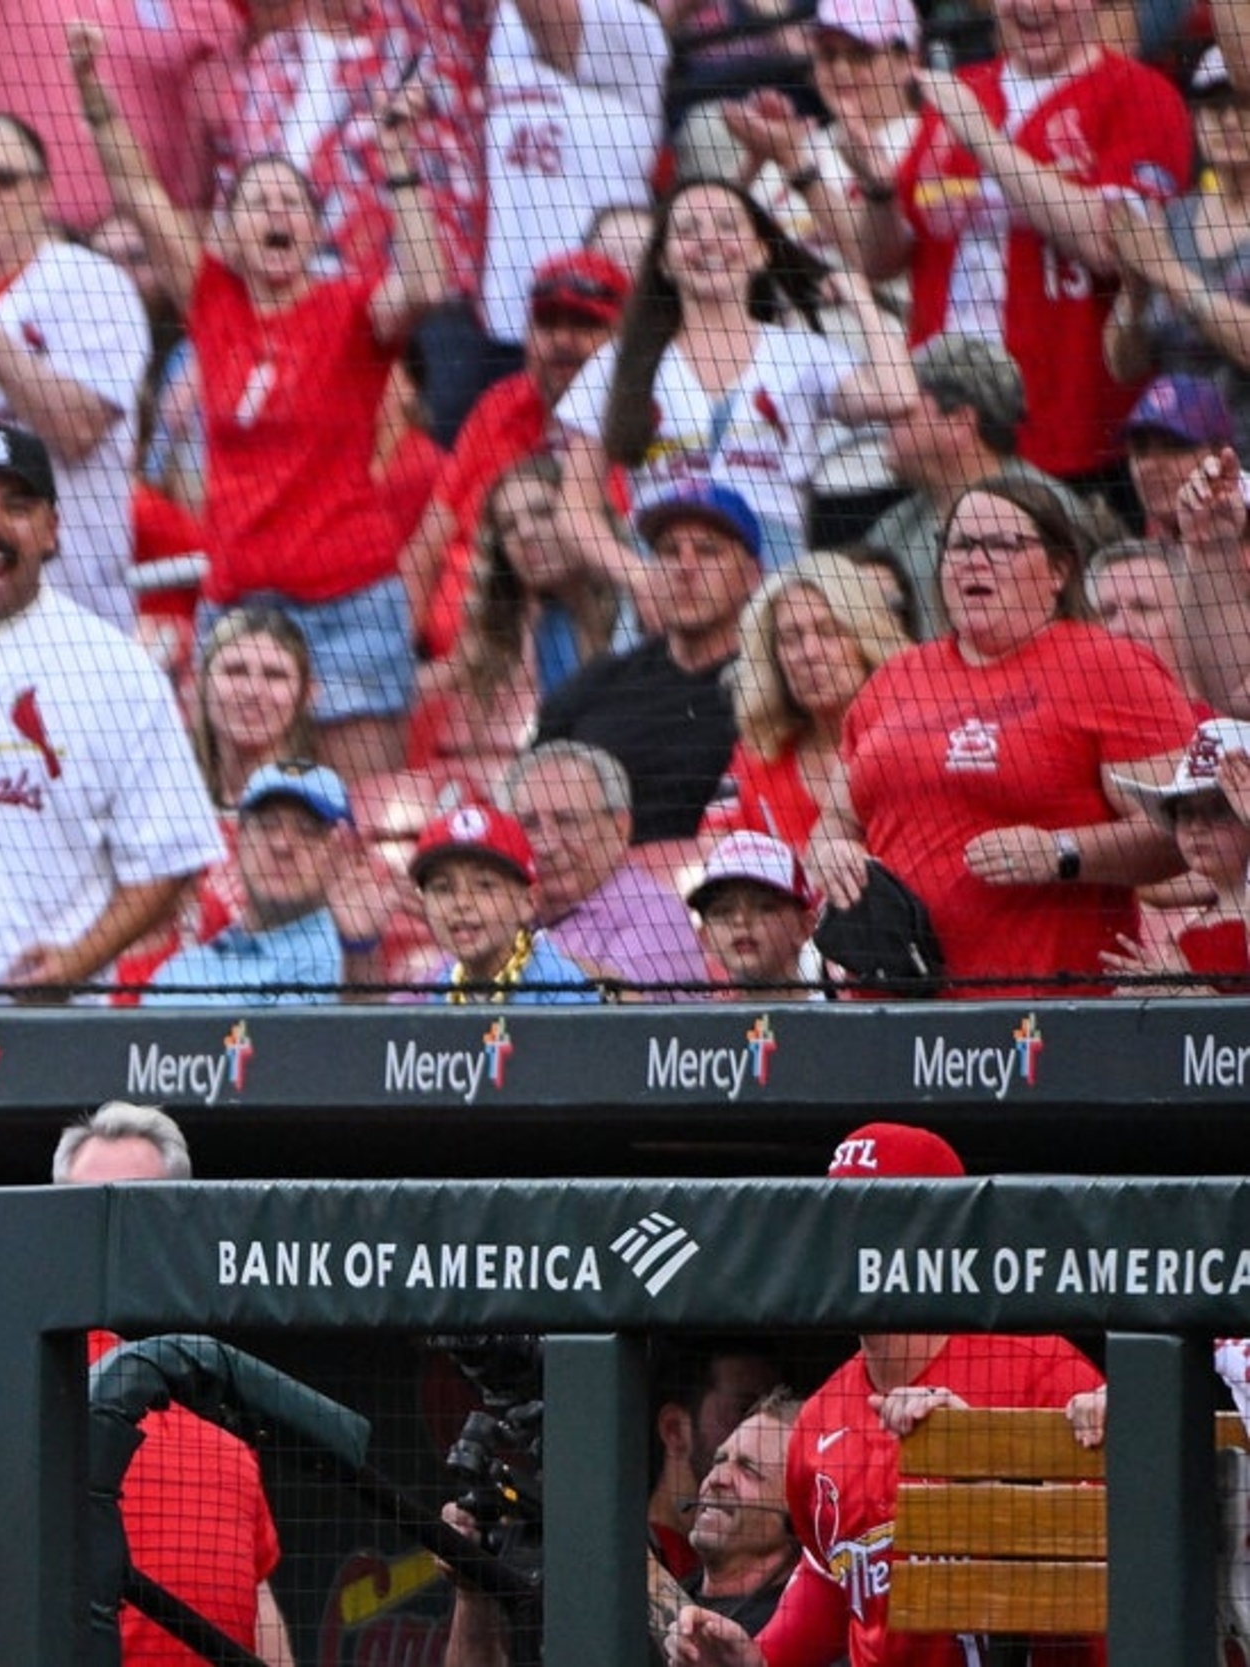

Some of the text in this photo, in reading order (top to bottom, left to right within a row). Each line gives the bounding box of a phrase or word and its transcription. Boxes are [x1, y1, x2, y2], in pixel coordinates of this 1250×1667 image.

[126, 1042, 226, 1104] Mercy
[384, 1039, 485, 1103] Mercy
[646, 1036, 748, 1100] Mercy
[912, 1036, 1015, 1100] Mercy
[218, 1240, 602, 1291] BANK OF AMERICA
[858, 1246, 1250, 1295] BANK OF AMERICA
